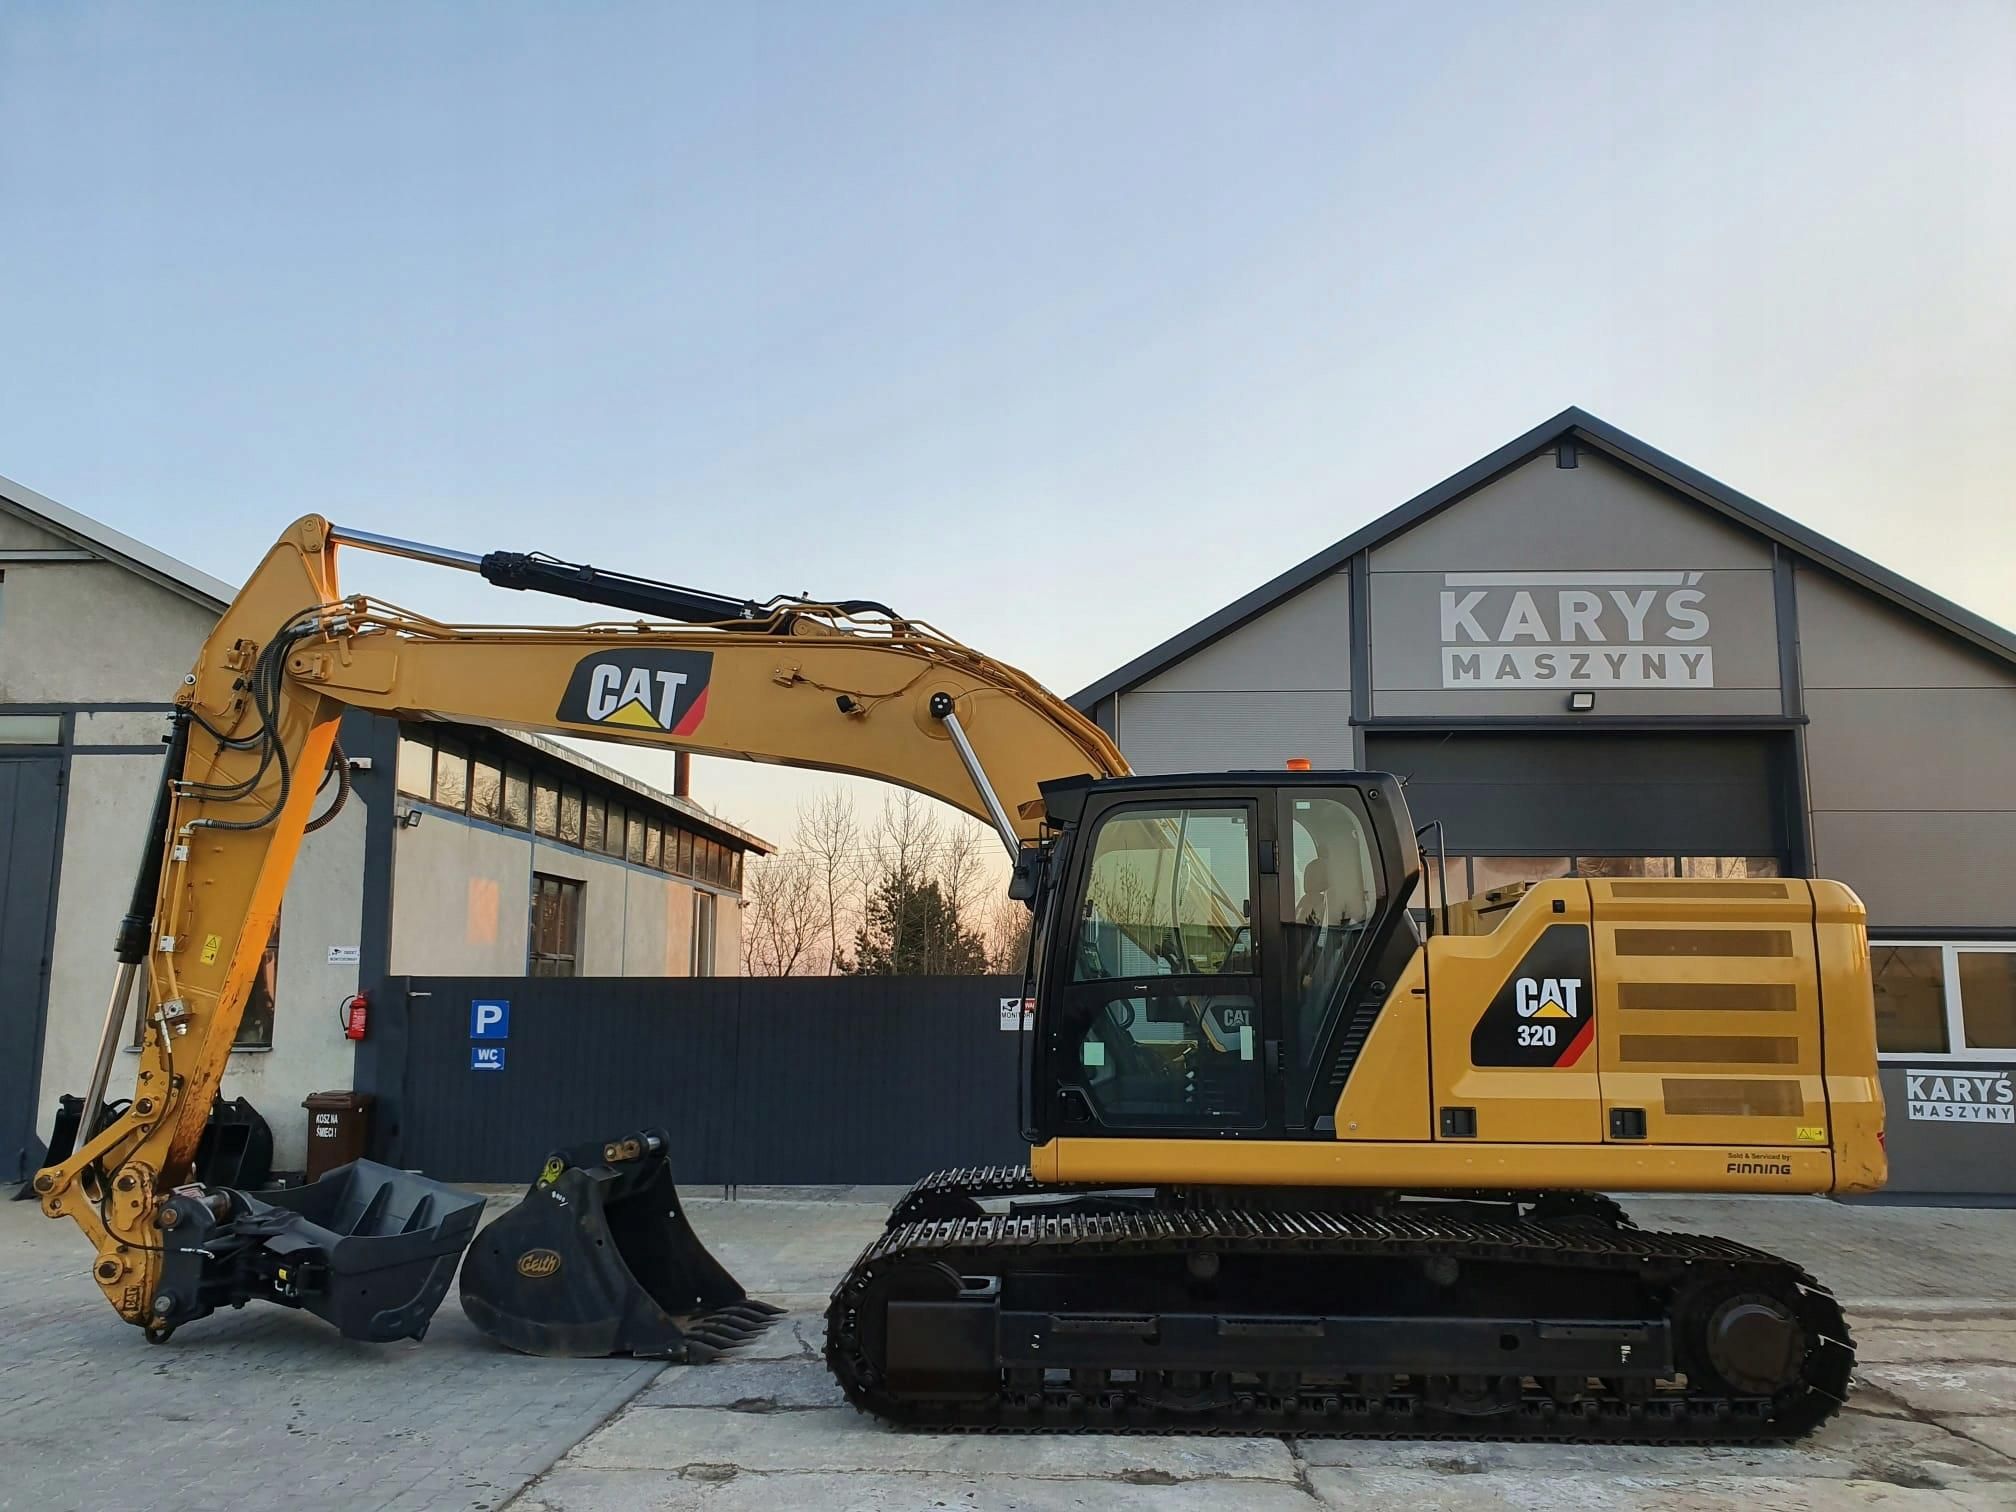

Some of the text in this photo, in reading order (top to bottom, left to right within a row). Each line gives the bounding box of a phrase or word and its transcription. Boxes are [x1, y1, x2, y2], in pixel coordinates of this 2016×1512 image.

[1440, 572, 1710, 641] KARYŚ
[1451, 652, 1704, 680] MASZYNY
[586, 664, 688, 730] CAT
[1516, 977, 1582, 1018] CAT
[476, 1005, 503, 1034] P
[1223, 1009, 1250, 1027] CAT
[1517, 1025, 1557, 1046] 320
[478, 1048, 499, 1061] WC
[1906, 1072, 2014, 1103] KARYŚ
[1912, 1105, 2011, 1120] MASZYNY
[1727, 1163, 1792, 1175] FINNING
[125, 1287, 138, 1308] CAT
